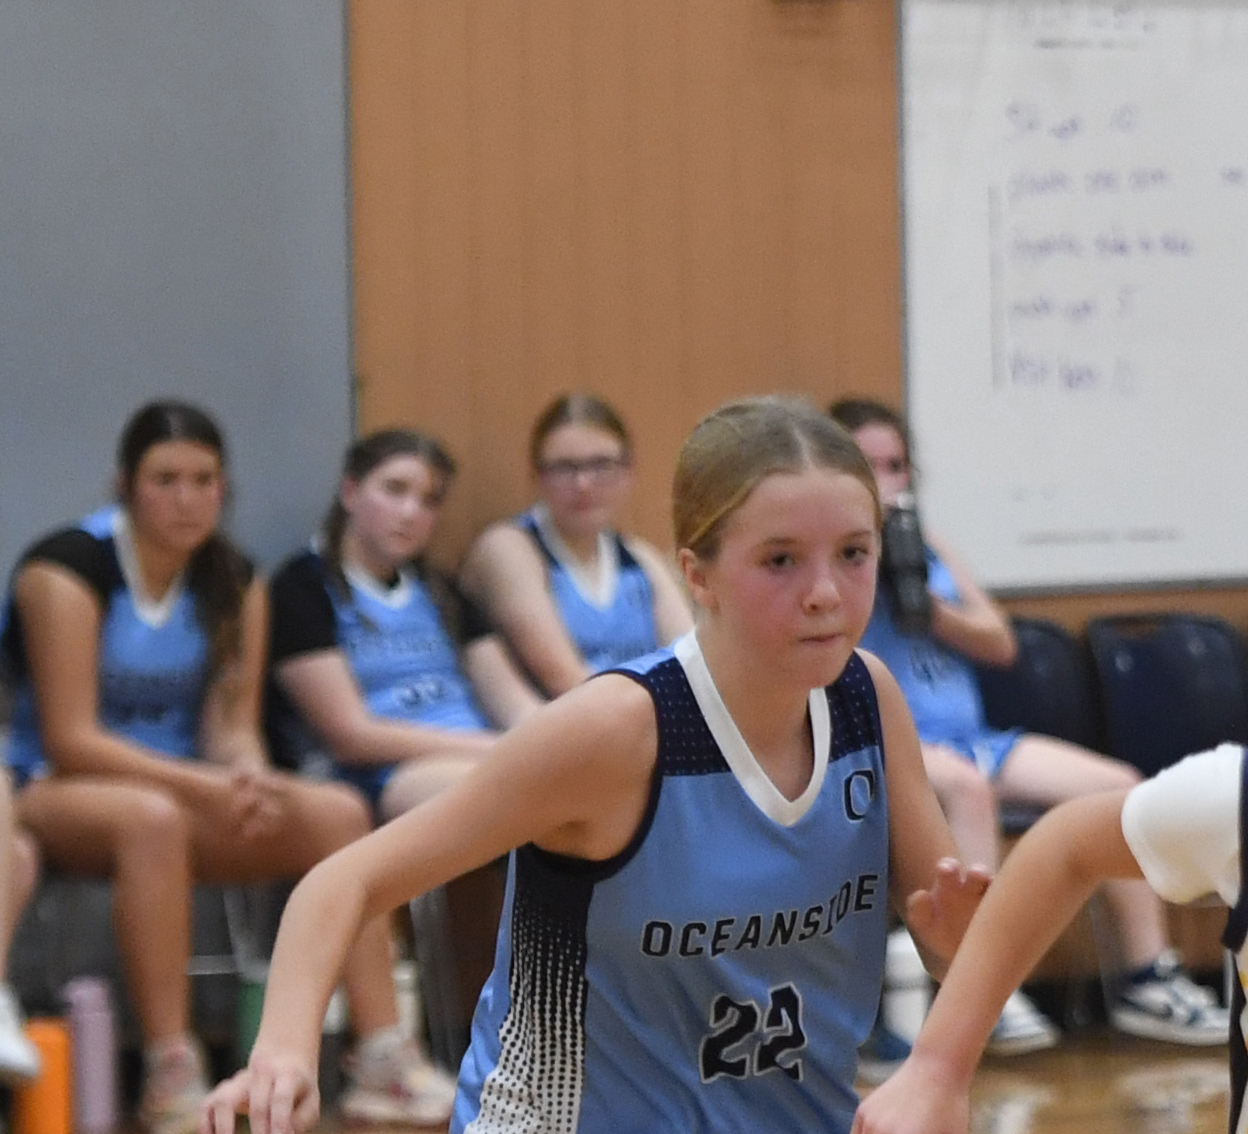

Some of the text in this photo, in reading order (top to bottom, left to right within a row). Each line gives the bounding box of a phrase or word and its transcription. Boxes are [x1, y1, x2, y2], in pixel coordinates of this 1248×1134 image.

[843, 769, 876, 824] O
[640, 873, 879, 959] OCEANSIDE
[700, 981, 808, 1084] 22
